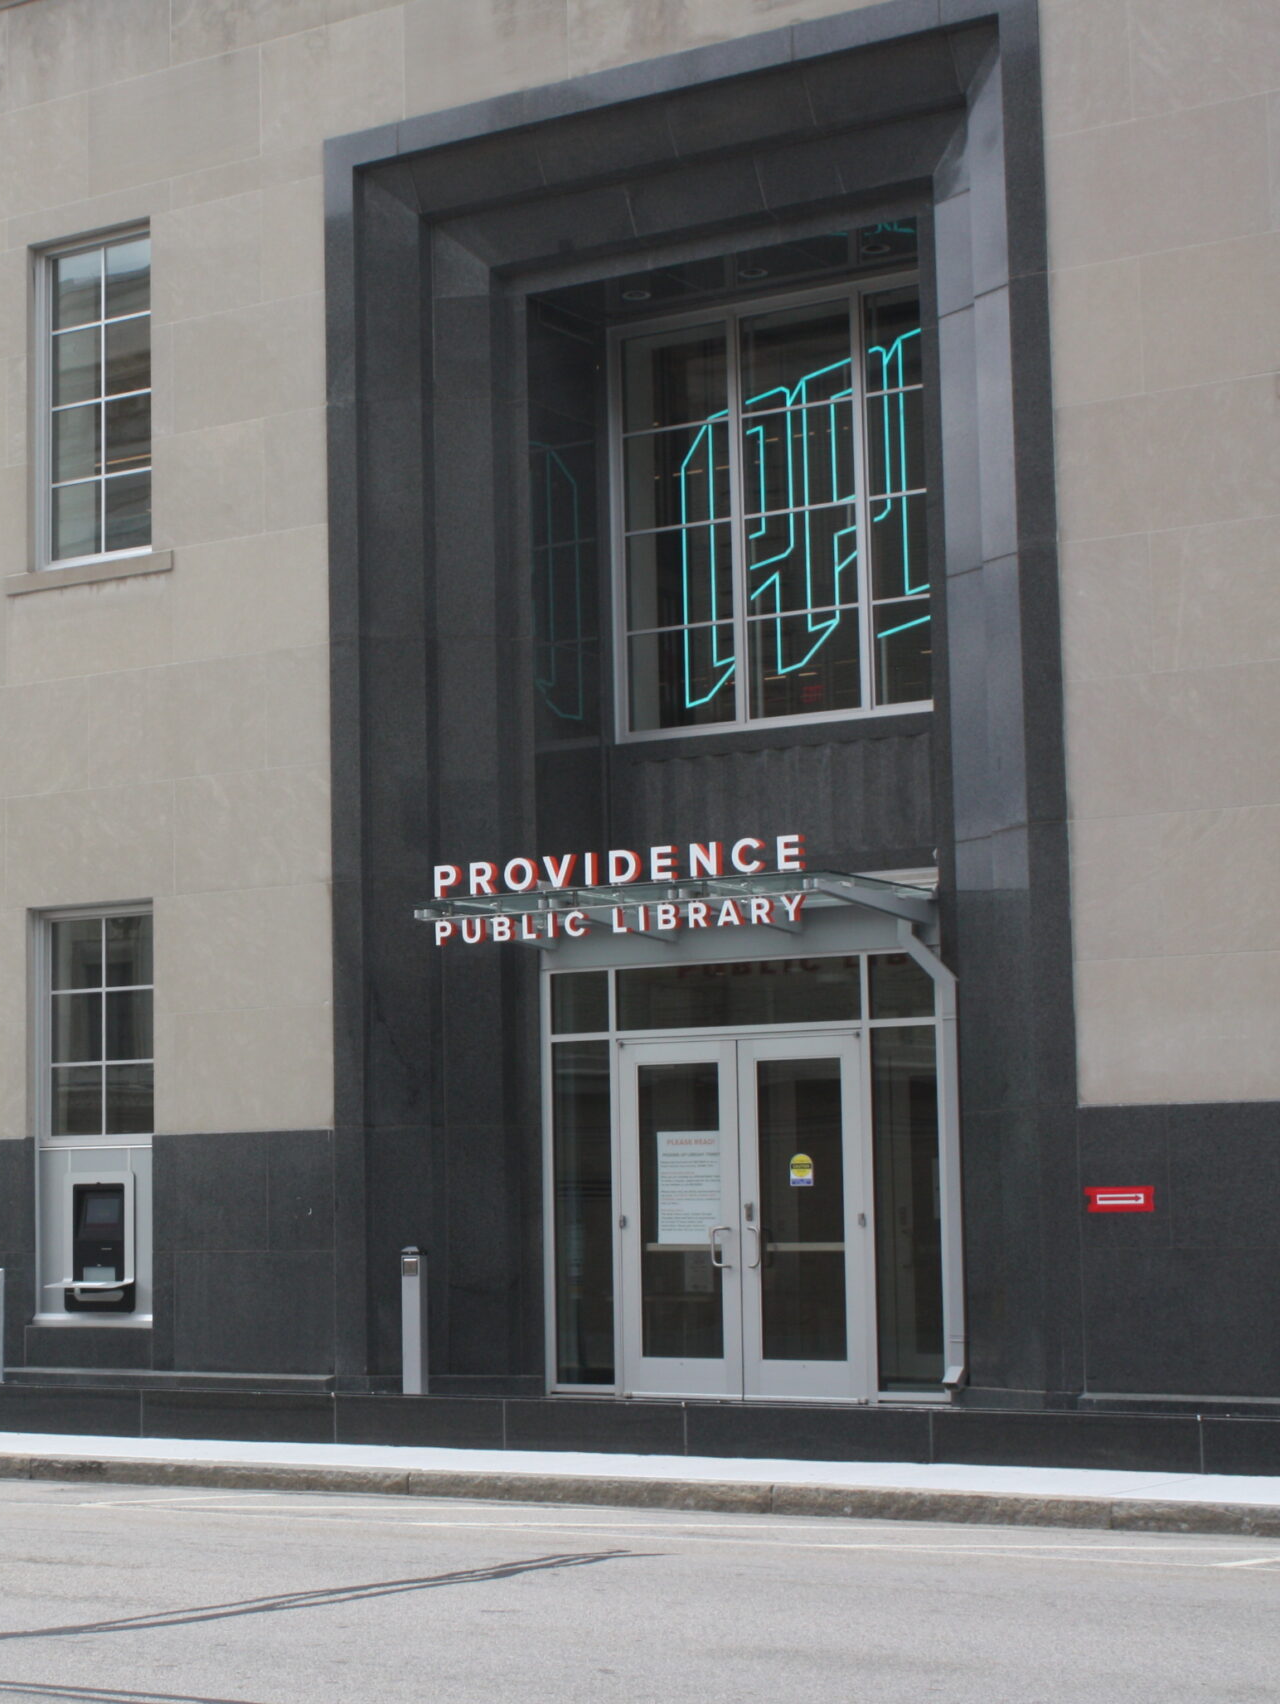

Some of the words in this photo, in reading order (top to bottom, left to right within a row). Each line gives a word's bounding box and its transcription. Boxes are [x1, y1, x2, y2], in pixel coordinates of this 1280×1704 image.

[433, 834, 806, 898] PROVIDENCE
[434, 910, 590, 946] PUBLIC
[612, 895, 807, 933] LIBRARY
